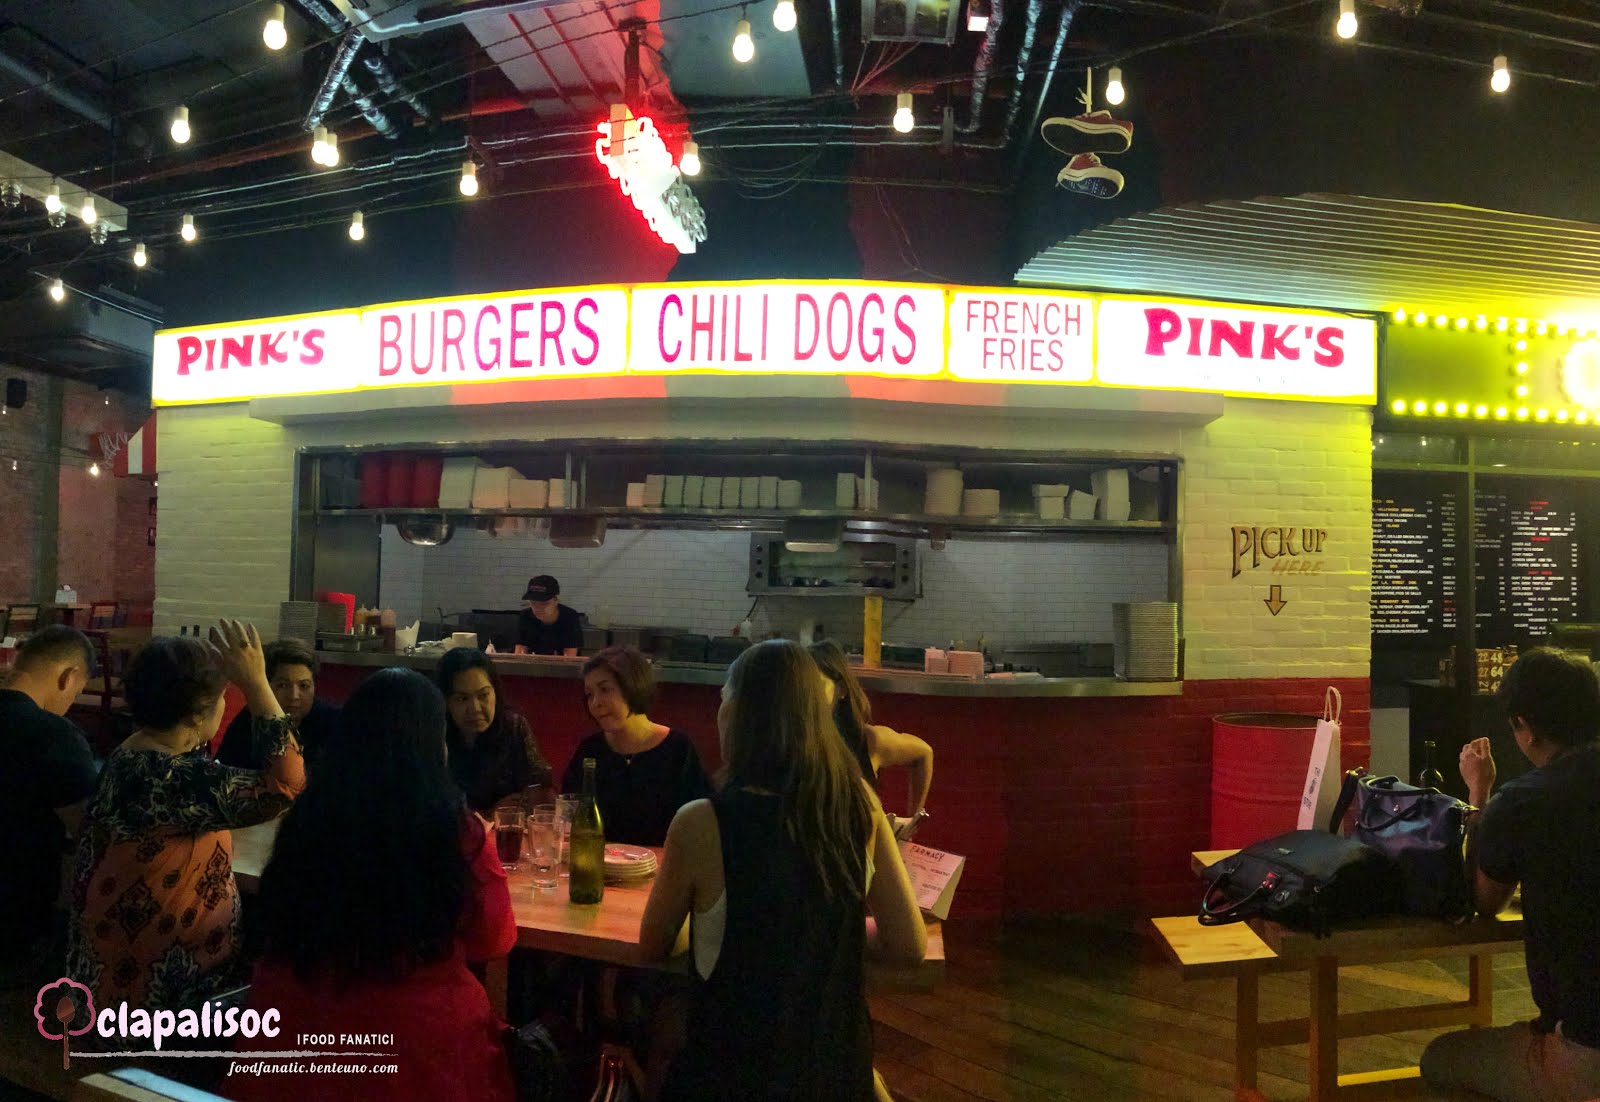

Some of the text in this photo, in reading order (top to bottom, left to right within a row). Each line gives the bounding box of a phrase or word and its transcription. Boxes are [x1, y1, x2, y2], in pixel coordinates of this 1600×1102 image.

[658, 291, 917, 365] CHILI DOGS
[966, 299, 1081, 336] FRENCH
[176, 328, 326, 376] PINK'S
[378, 297, 600, 377] BURGERS
[982, 337, 1064, 372] FRIES
[1143, 307, 1345, 368] PINK'S
[1230, 526, 1328, 579] PICK UP
[1271, 560, 1325, 576] HERE
[1490, 652, 1503, 664] 48
[1490, 666, 1503, 678] 64
[910, 845, 946, 861] FARMACY
